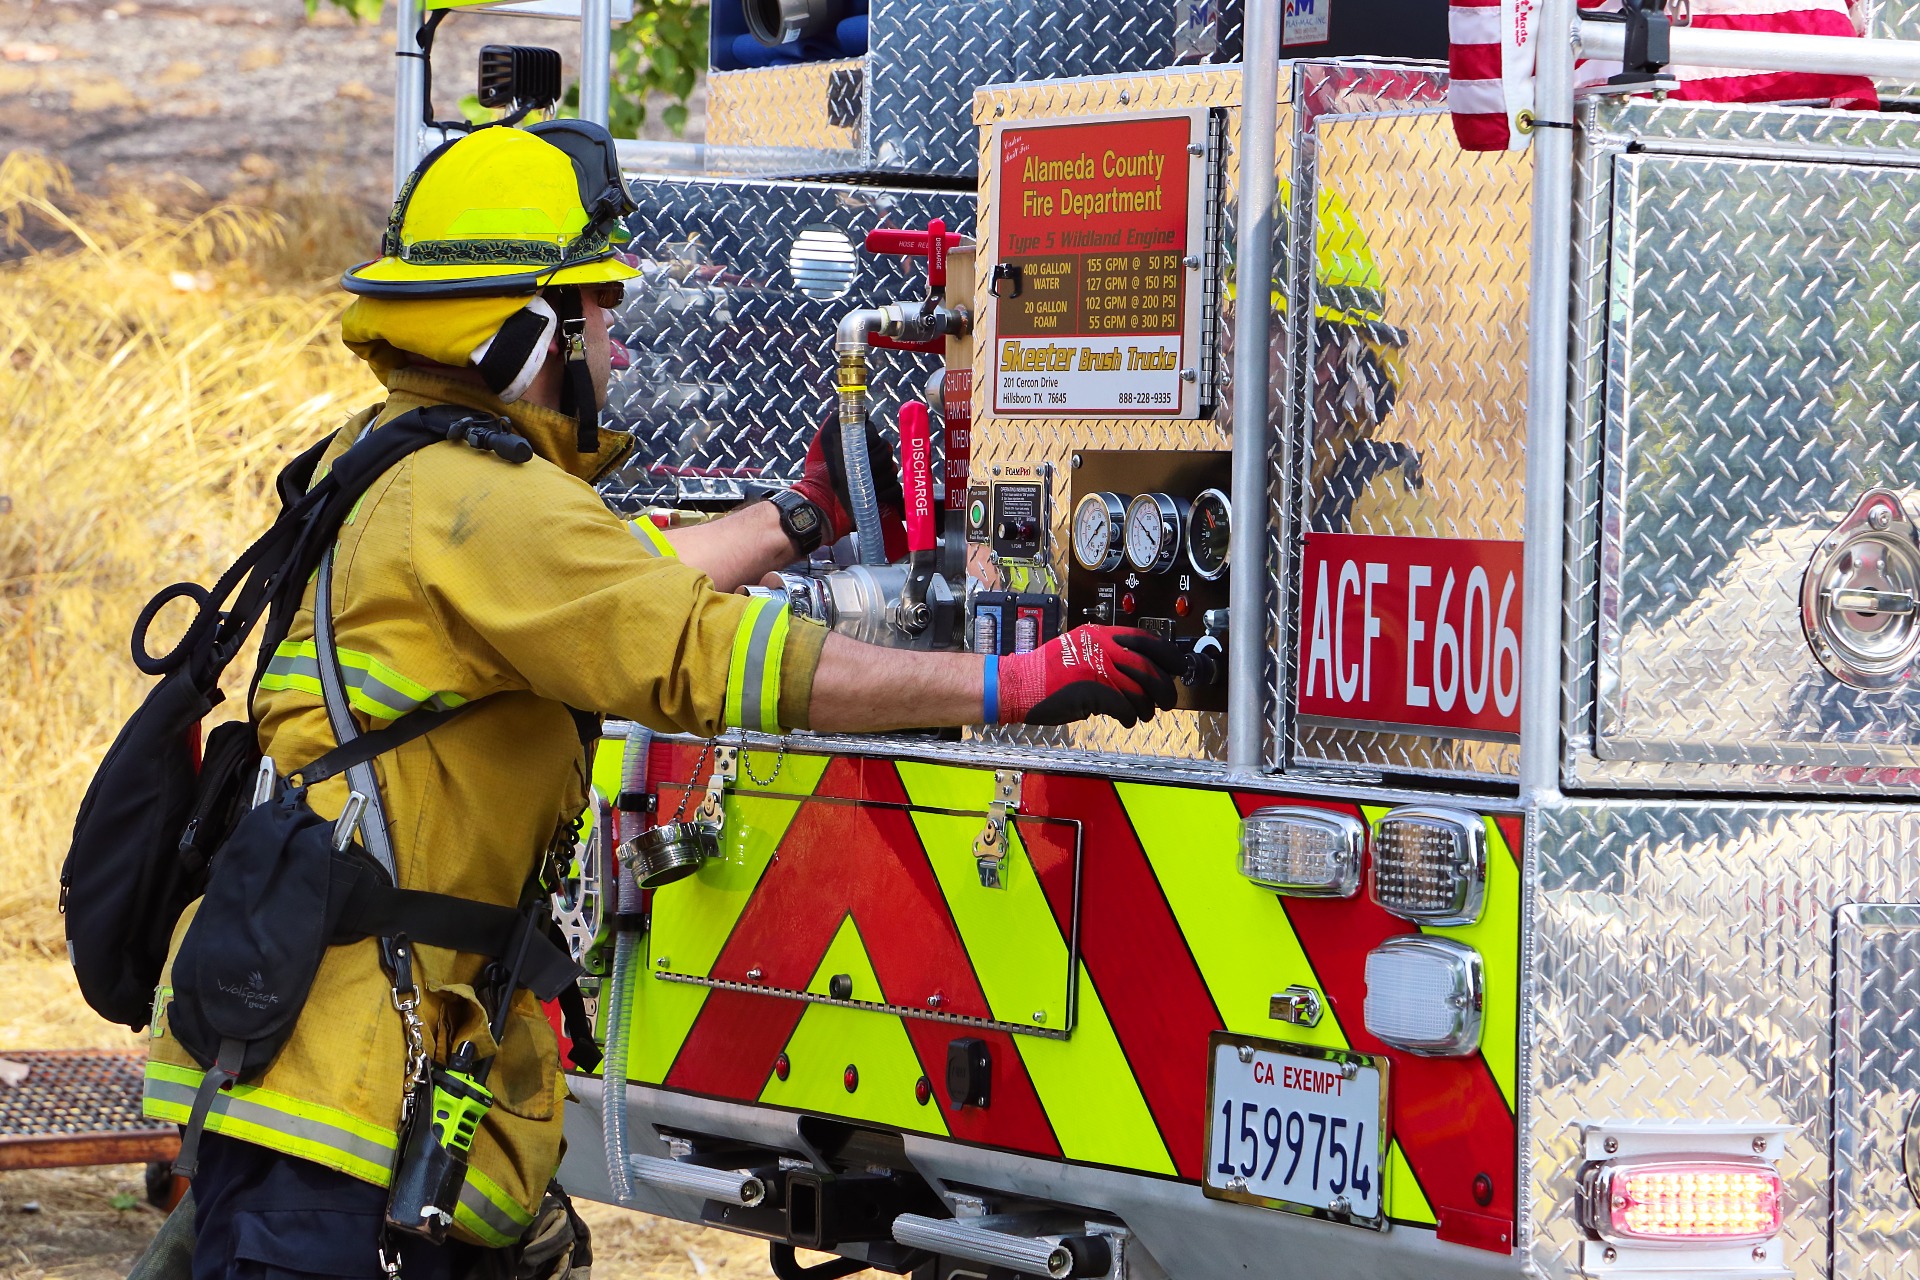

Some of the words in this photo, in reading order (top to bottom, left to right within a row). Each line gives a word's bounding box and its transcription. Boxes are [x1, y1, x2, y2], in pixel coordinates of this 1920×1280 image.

[1022, 152, 1095, 183] Alameda
[1102, 149, 1165, 181] County
[1022, 190, 1054, 218] Fire
[1060, 184, 1162, 220] Department
[1008, 233, 1041, 254] Type
[1045, 231, 1056, 248] 5
[1061, 229, 1122, 248] Wildland
[1126, 227, 1176, 249] Engine
[1023, 263, 1038, 276] 400
[1040, 262, 1071, 275] GALLON
[1086, 258, 1102, 272] 155
[1105, 257, 1128, 271] GPM
[1132, 257, 1141, 271] @
[1148, 256, 1160, 270] 50
[1163, 255, 1178, 269] PSI
[1033, 277, 1060, 290] WATER
[1086, 277, 1102, 291] 127
[1104, 276, 1127, 290] GPM
[1131, 276, 1140, 290] @
[1144, 275, 1160, 289] 150
[1163, 275, 1177, 289] PSI
[1024, 302, 1034, 314] 20
[1036, 301, 1068, 313] GALLON
[1085, 297, 1101, 310] 102
[1104, 296, 1127, 310] GPM
[1131, 296, 1140, 309] @
[1142, 295, 1159, 309] 200
[1162, 294, 1176, 308] PSI
[1033, 315, 1057, 328] FOAM
[1089, 315, 1100, 329] 55
[1103, 315, 1126, 329] GPM
[1130, 315, 1139, 328] @
[1141, 314, 1158, 328] 300
[1161, 314, 1176, 328] PSI
[1000, 340, 1077, 372] Skeeter
[1078, 347, 1123, 372] Brush
[1127, 346, 1177, 371] Trucks
[946, 373, 962, 392] SHUT
[962, 372, 972, 391] OF
[1003, 377, 1015, 388] 201
[1016, 377, 1039, 388] Cercon
[1041, 376, 1059, 388] Drive
[1003, 393, 1032, 404] Hillsboro
[1034, 393, 1043, 404] TX
[1047, 392, 1067, 404] 76645
[1118, 392, 1172, 404] 888-228-9335
[946, 401, 961, 420] TANK
[961, 400, 972, 419] FIL
[951, 430, 969, 448] WHEN
[911, 438, 929, 517] DISCHARGE
[947, 459, 970, 478] FLOWIN
[1145, 619, 1165, 630] PRIME
[1306, 559, 1388, 703] ACF
[1406, 564, 1520, 718] E606
[217, 978, 279, 1004] Wolfpack
[1253, 1061, 1275, 1086] CA
[1283, 1065, 1344, 1097] EXEMPT
[1217, 1099, 1371, 1201] 1599754
